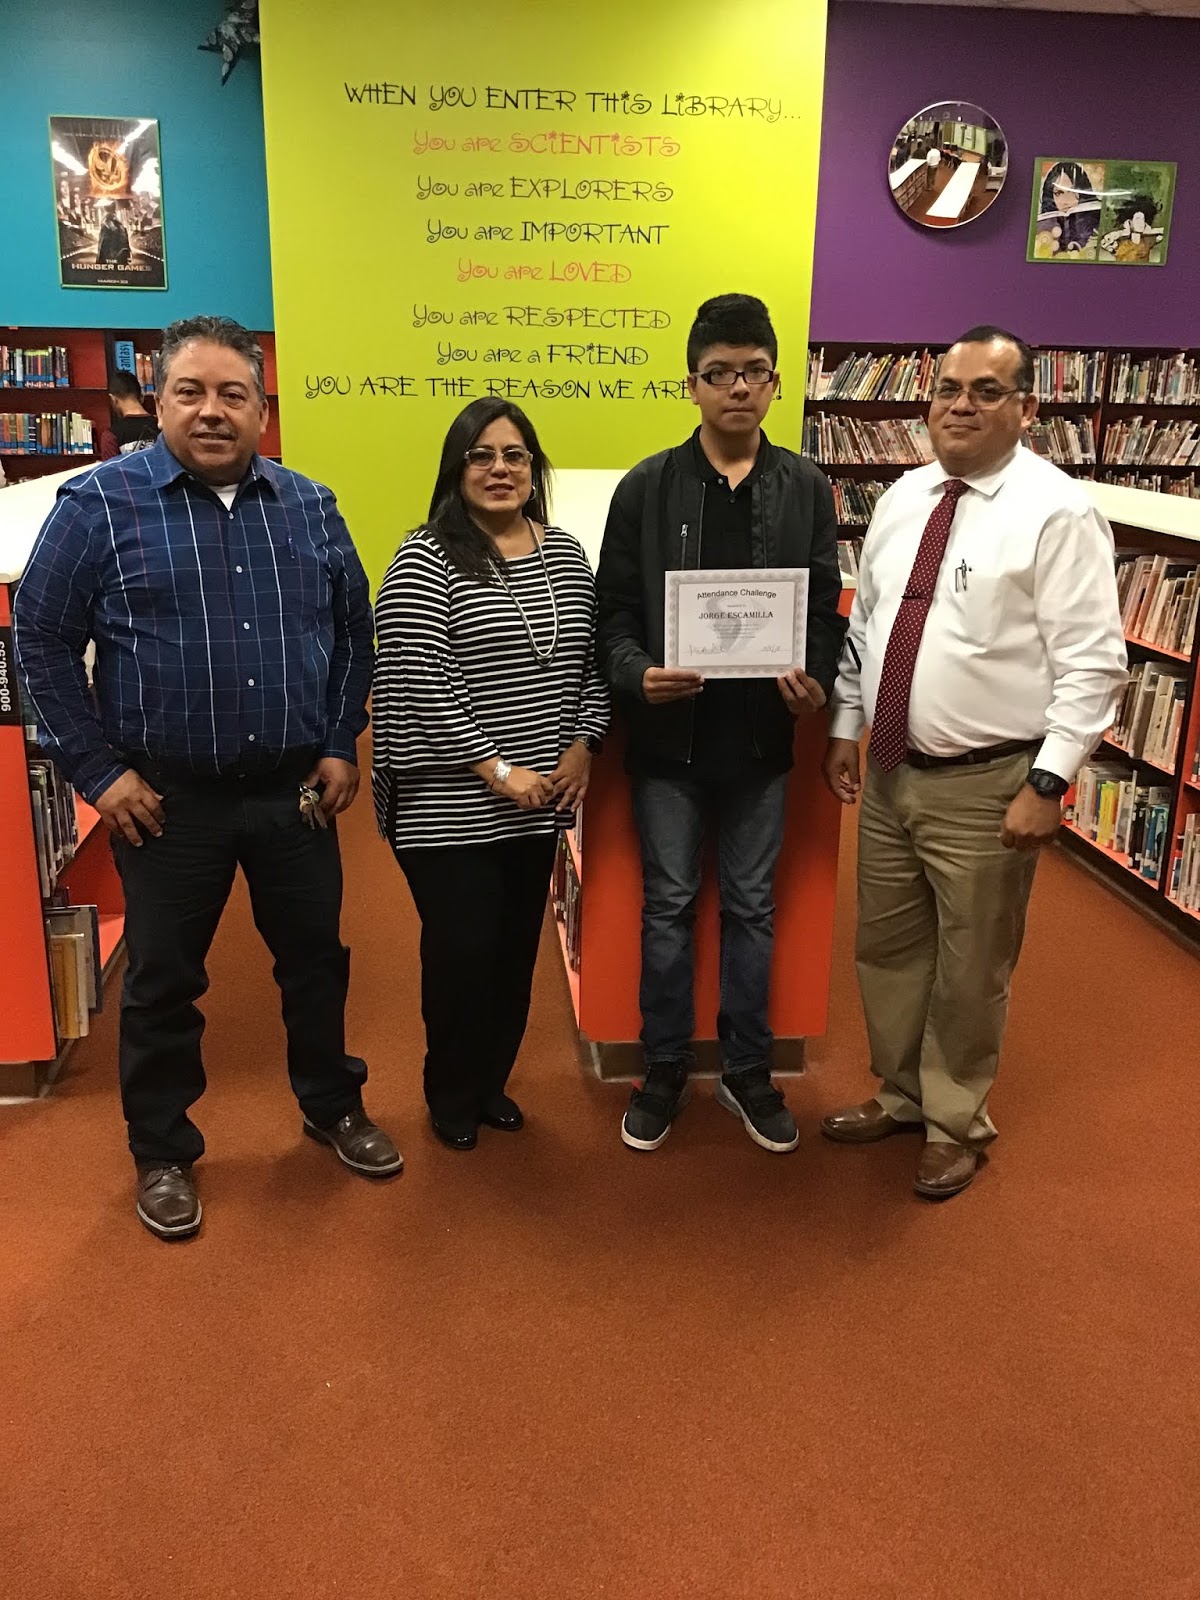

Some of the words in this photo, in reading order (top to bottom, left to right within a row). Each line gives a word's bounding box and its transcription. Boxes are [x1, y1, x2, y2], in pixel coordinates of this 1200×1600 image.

[344, 82, 416, 105] WHEN
[429, 85, 476, 111] YOU
[485, 86, 576, 112] ENTER
[413, 131, 456, 155] You
[462, 137, 503, 153] are
[416, 175, 459, 200] You
[464, 182, 505, 198] are
[509, 176, 674, 202] EXPLORERS
[426, 219, 469, 243] You
[474, 225, 514, 241] are
[519, 221, 670, 245] IMPORTANT
[72, 263, 114, 271] HUNGER
[457, 258, 499, 282] You
[504, 265, 543, 281] are
[549, 261, 632, 283] LOVED
[413, 304, 454, 328] You
[459, 310, 499, 326] are
[503, 305, 671, 329] RESPECTED
[437, 341, 478, 365] You
[483, 348, 522, 364] are
[527, 350, 541, 364] a
[305, 375, 351, 399] YOU
[360, 375, 418, 397] ARE
[425, 376, 478, 398] THE
[483, 377, 590, 399] REASON
[598, 378, 635, 399] WE
[642, 379, 690, 400] ARE
[697, 590, 738, 600] Attendance
[740, 589, 777, 599] Challenge
[727, 611, 774, 619] ESCAMILLA
